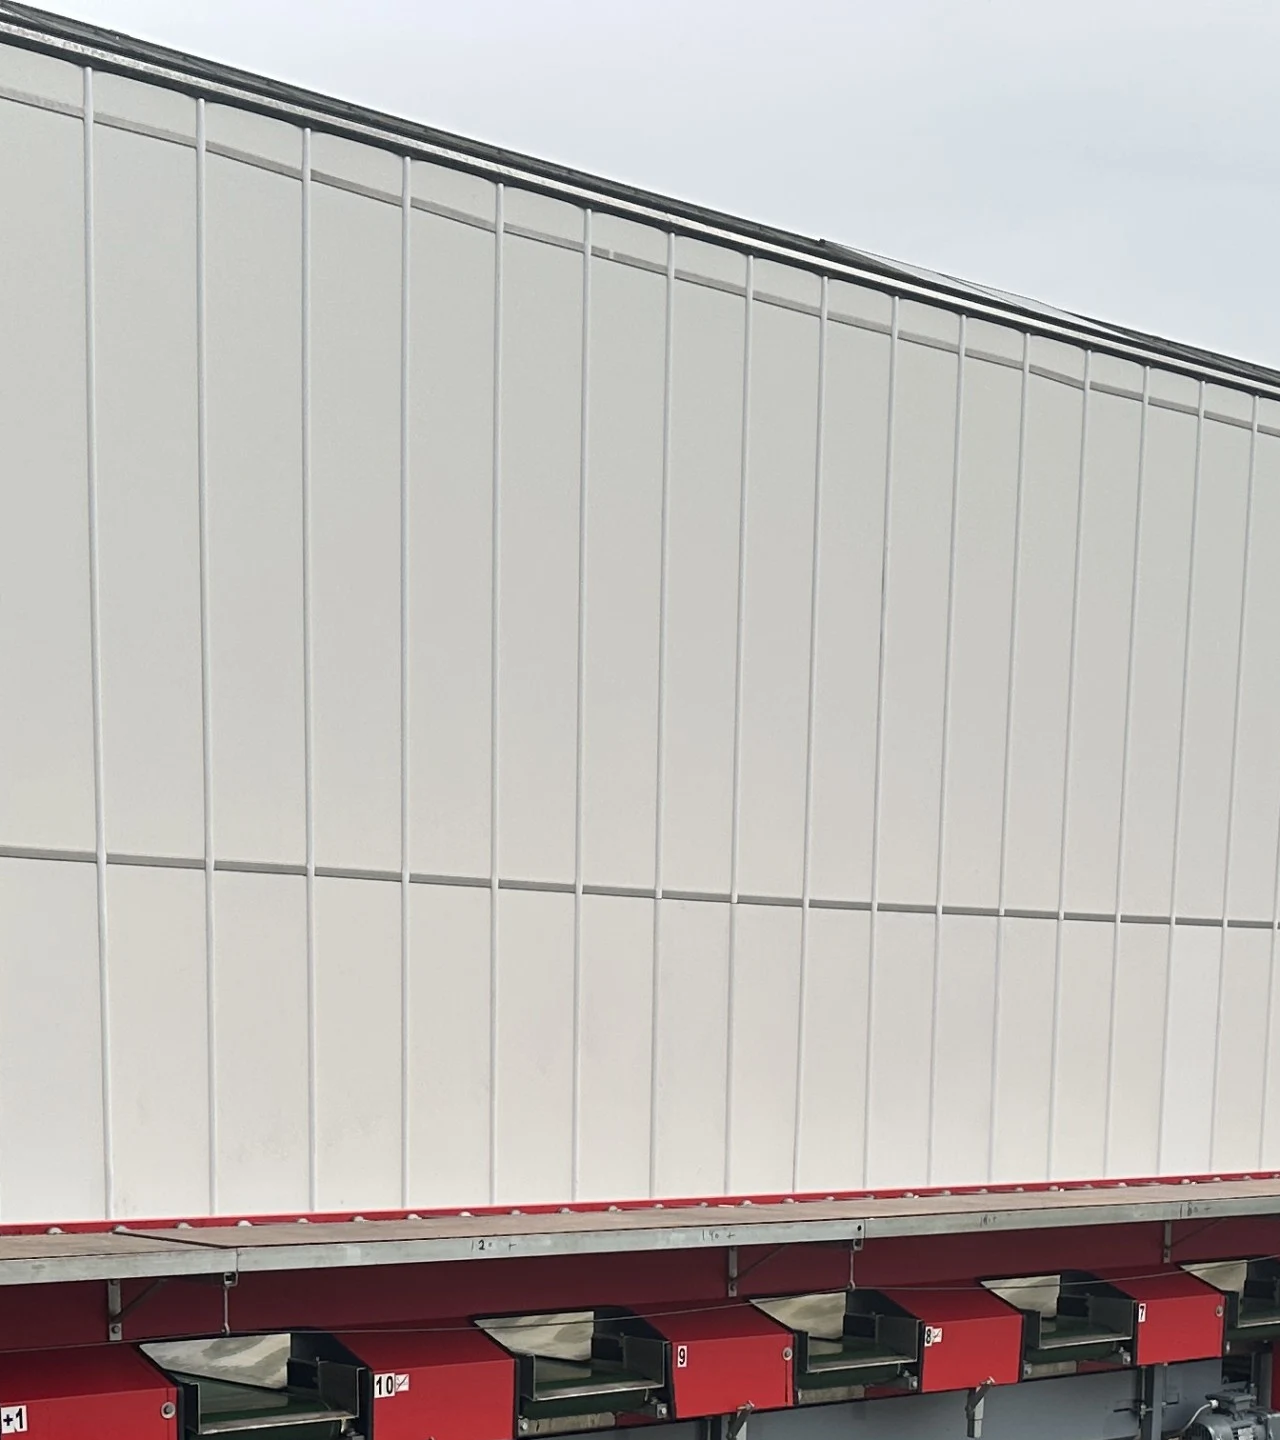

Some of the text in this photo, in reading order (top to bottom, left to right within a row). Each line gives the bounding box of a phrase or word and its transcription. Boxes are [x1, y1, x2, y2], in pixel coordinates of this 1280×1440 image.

[925, 1327, 932, 1345] 8
[678, 1347, 686, 1366] 9
[376, 1374, 394, 1396] 10
